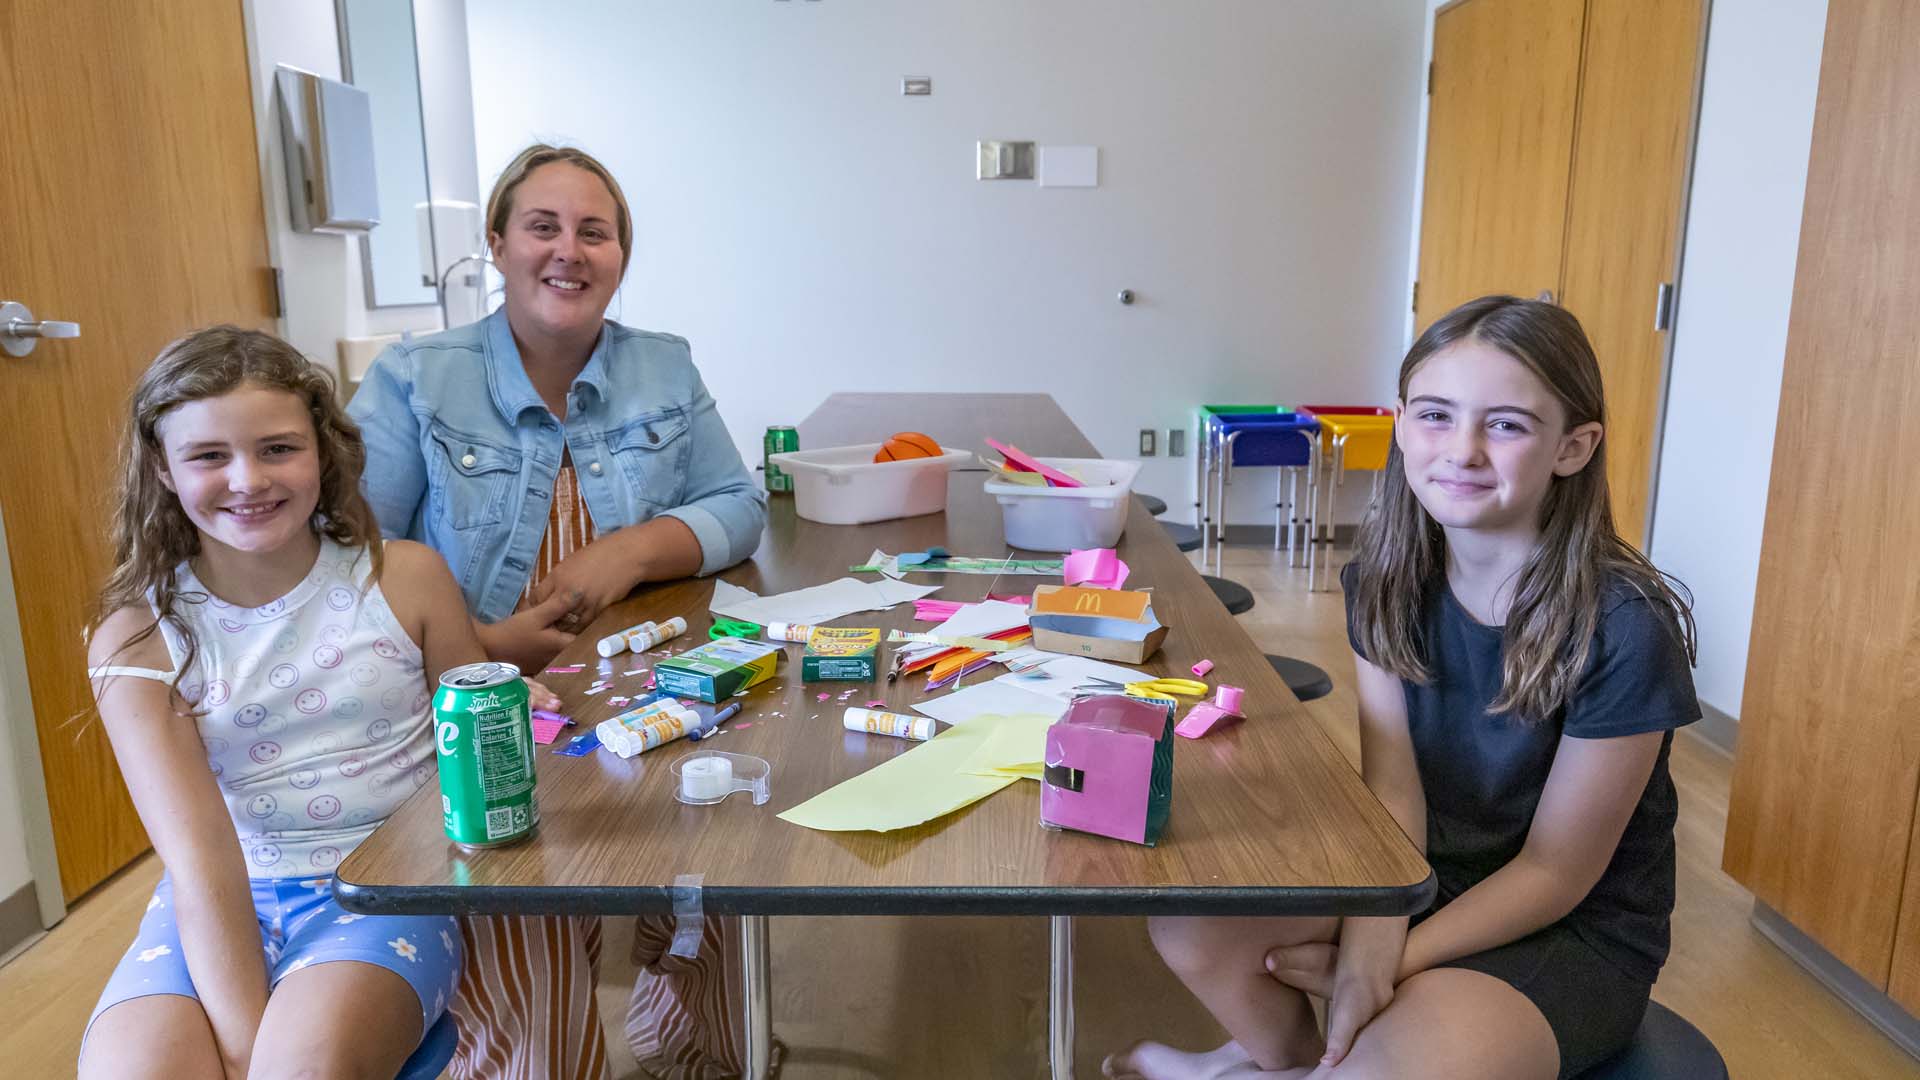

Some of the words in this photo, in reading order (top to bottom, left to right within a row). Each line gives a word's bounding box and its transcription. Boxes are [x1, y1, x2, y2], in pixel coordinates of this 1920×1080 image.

[467, 692, 501, 713] Sprite
[479, 710, 505, 721] Nutrition
[481, 733, 506, 742] Calories
